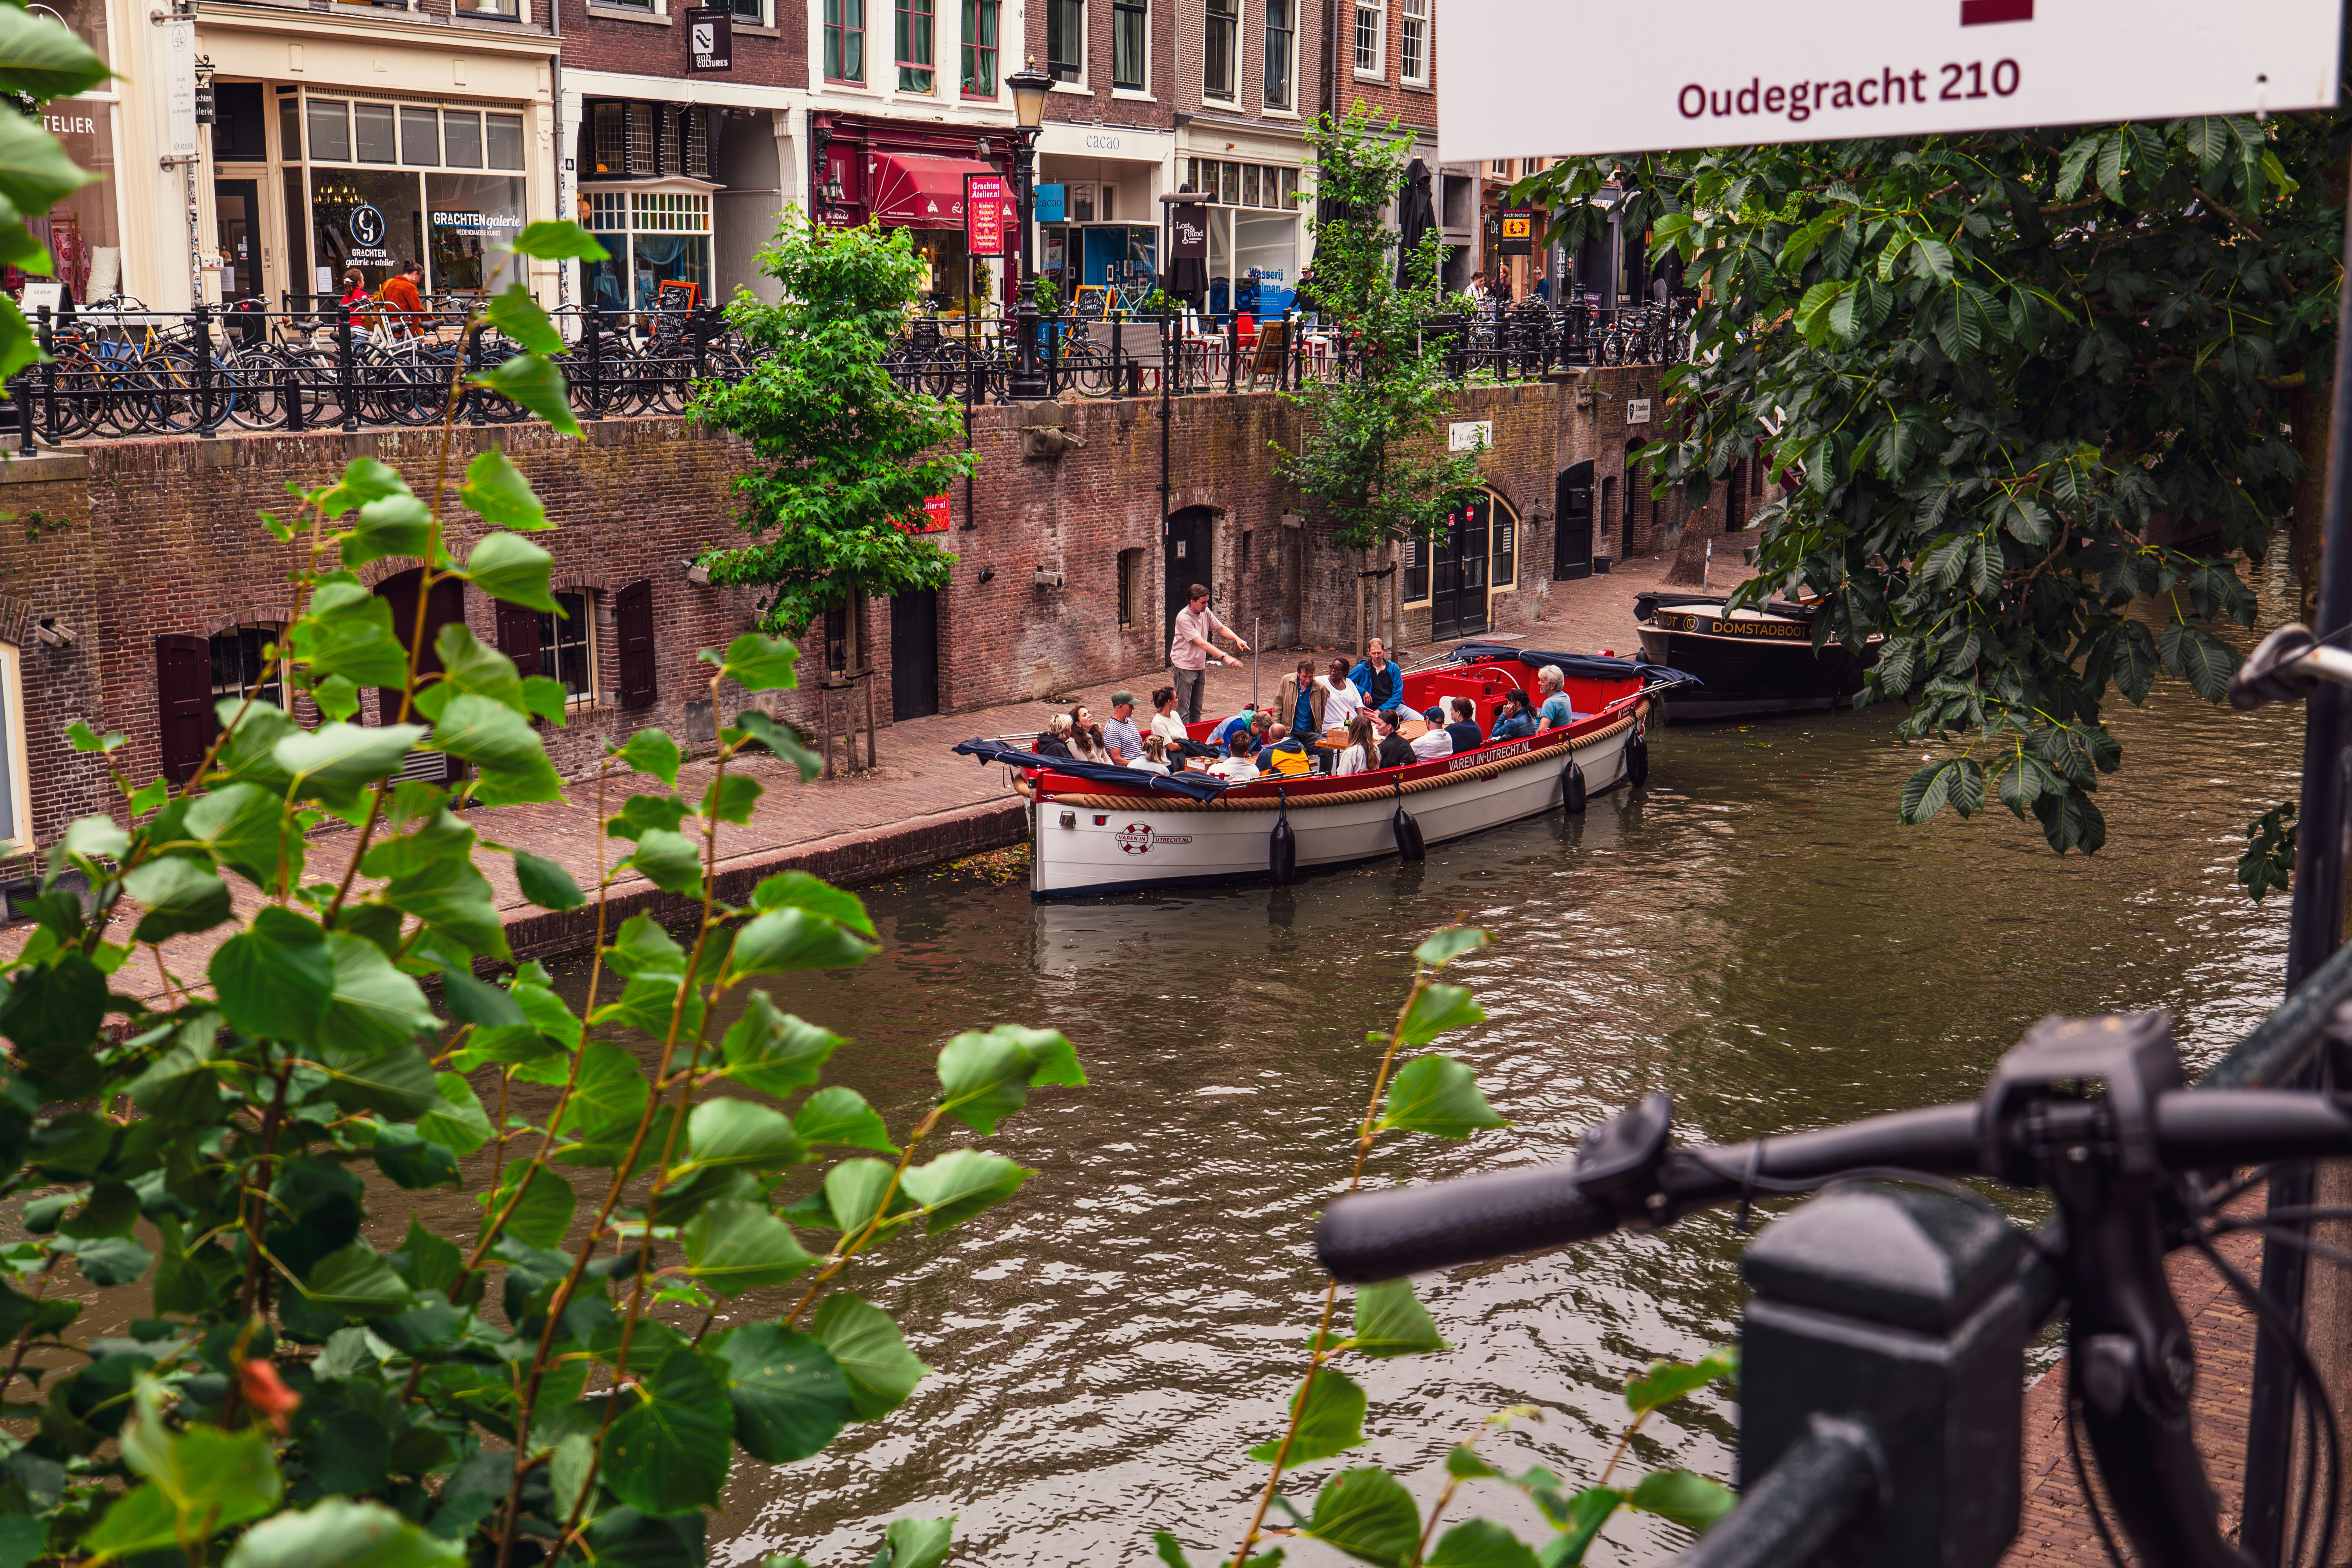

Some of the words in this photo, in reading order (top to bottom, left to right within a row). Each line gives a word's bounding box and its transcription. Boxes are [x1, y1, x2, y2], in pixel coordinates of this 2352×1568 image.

[697, 59, 728, 68] CULTURES
[1677, 66, 1927, 123] Oudegracht
[1938, 58, 2020, 102] 210
[44, 115, 95, 134] TELIER
[1086, 135, 1120, 149] cacao
[972, 181, 1000, 190] Grachten
[434, 212, 485, 226] GRACHTEN
[486, 215, 521, 229] galerie
[1184, 229, 1203, 238] Found
[352, 249, 386, 257] GRACHTEN
[346, 258, 369, 268] galerie
[1041, 260, 1063, 270] cacao
[1133, 261, 1154, 271] cacao
[1249, 267, 1283, 282] Wasserij
[1635, 403, 1648, 412] Stunlux
[1712, 621, 1807, 637] DOMSTADBOOT
[1449, 755, 1474, 771] VAREN
[1477, 753, 1484, 765] IN
[1486, 741, 1531, 762] UTRECHT.NL
